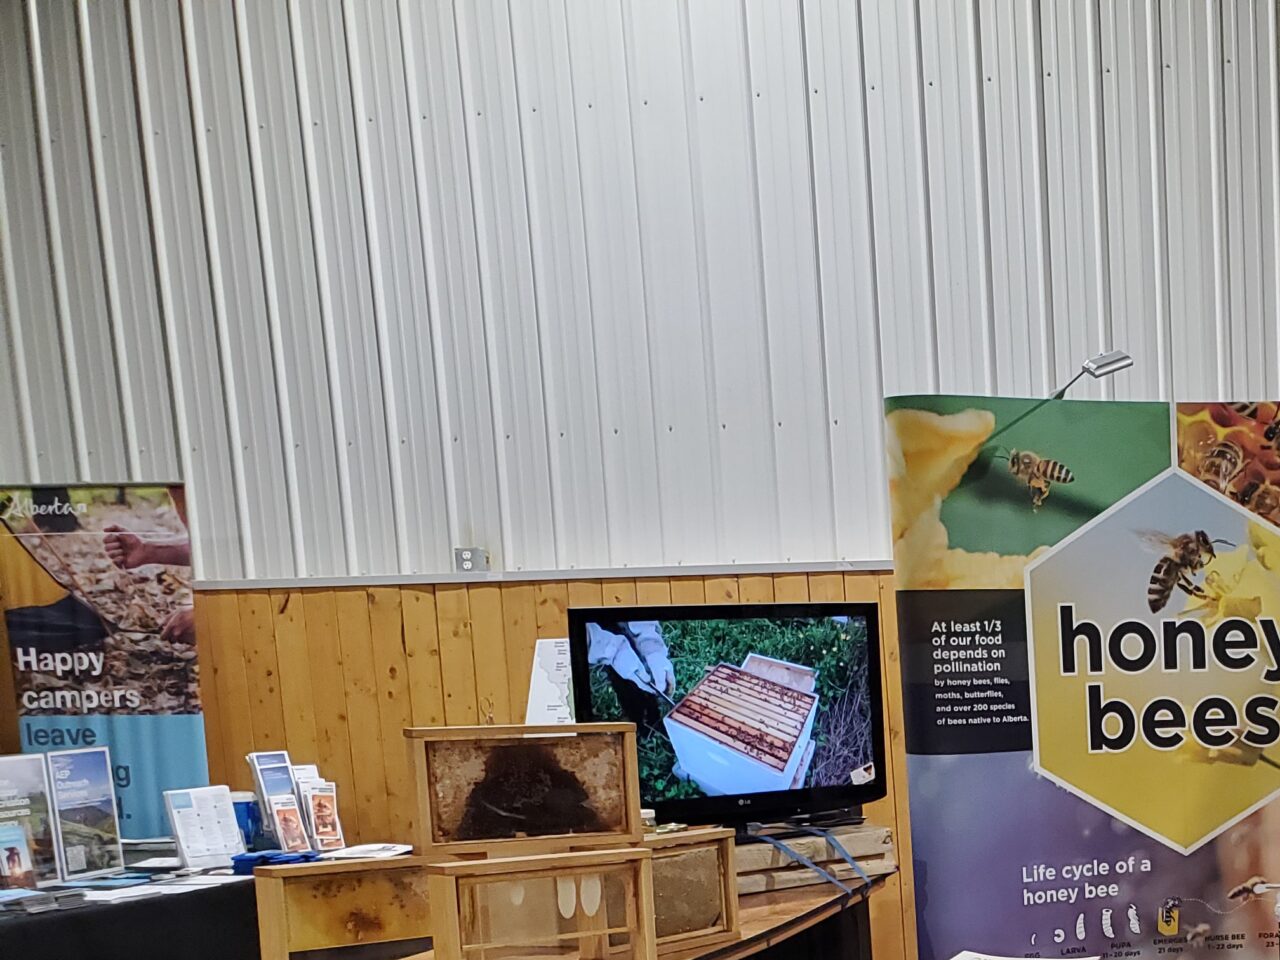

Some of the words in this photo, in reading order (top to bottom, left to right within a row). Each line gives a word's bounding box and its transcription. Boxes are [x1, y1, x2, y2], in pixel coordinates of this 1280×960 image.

[1, 492, 79, 518] Alberta
[931, 621, 947, 632] At
[951, 620, 980, 632] least
[984, 619, 1001, 633] 1/3
[932, 635, 946, 646] of
[950, 636, 971, 646] our
[975, 634, 1002, 645] food
[933, 648, 988, 660] depends
[991, 649, 1006, 658] on
[16, 647, 104, 676] Happy
[934, 661, 1001, 674] pollination
[935, 679, 945, 687] by
[22, 689, 140, 713] campers
[936, 691, 963, 699] moths,
[936, 704, 951, 712] and
[990, 703, 1015, 711] species
[937, 717, 945, 725] of
[948, 717, 967, 725] bees
[968, 716, 991, 724] native
[25, 723, 97, 746] leave
[1022, 864, 1056, 882] Life
[1062, 859, 1110, 881] cycle
[1115, 856, 1135, 873] of
[1140, 859, 1151, 871] a
[1023, 887, 1079, 906] honey
[1084, 882, 1119, 898] bee
[1226, 943, 1243, 951] days
